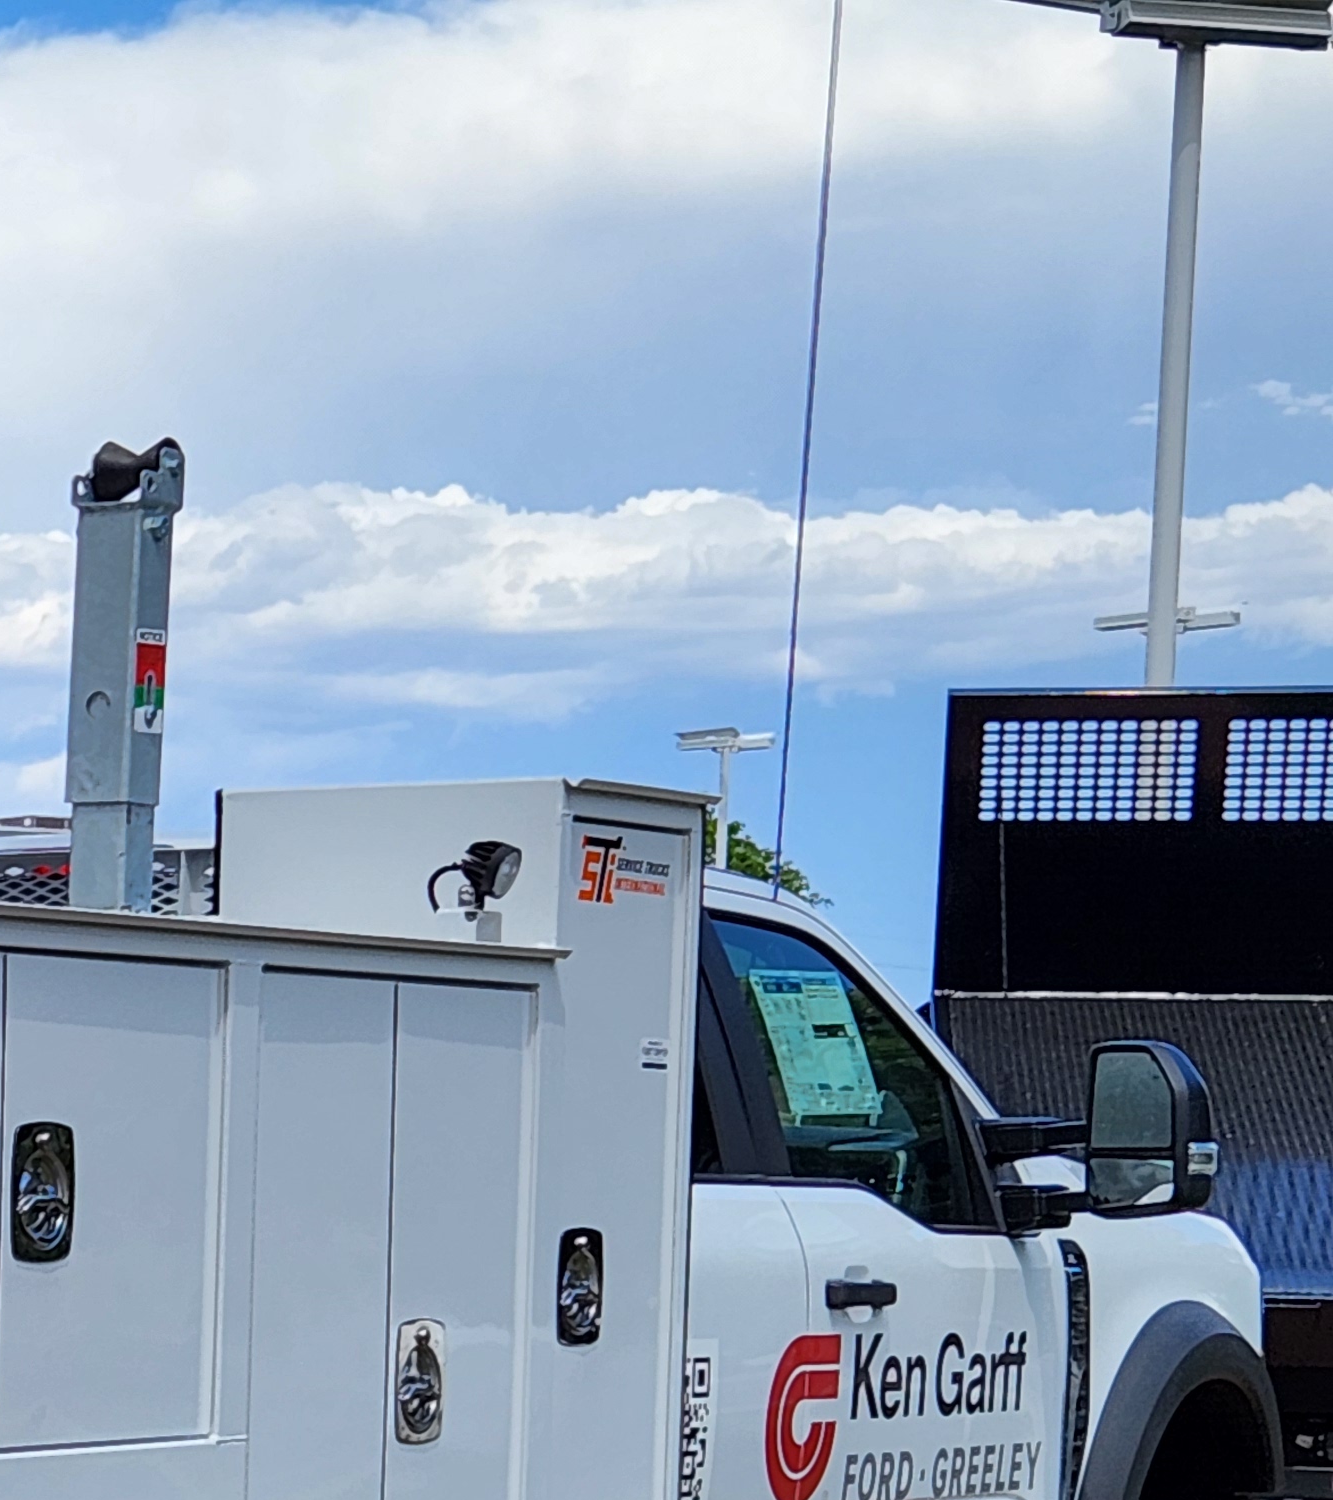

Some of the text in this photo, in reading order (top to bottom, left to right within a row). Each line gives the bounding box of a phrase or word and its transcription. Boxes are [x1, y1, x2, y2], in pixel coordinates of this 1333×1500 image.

[850, 1331, 1028, 1420] Ken Garff
[932, 1441, 1042, 1499] GREELEY
